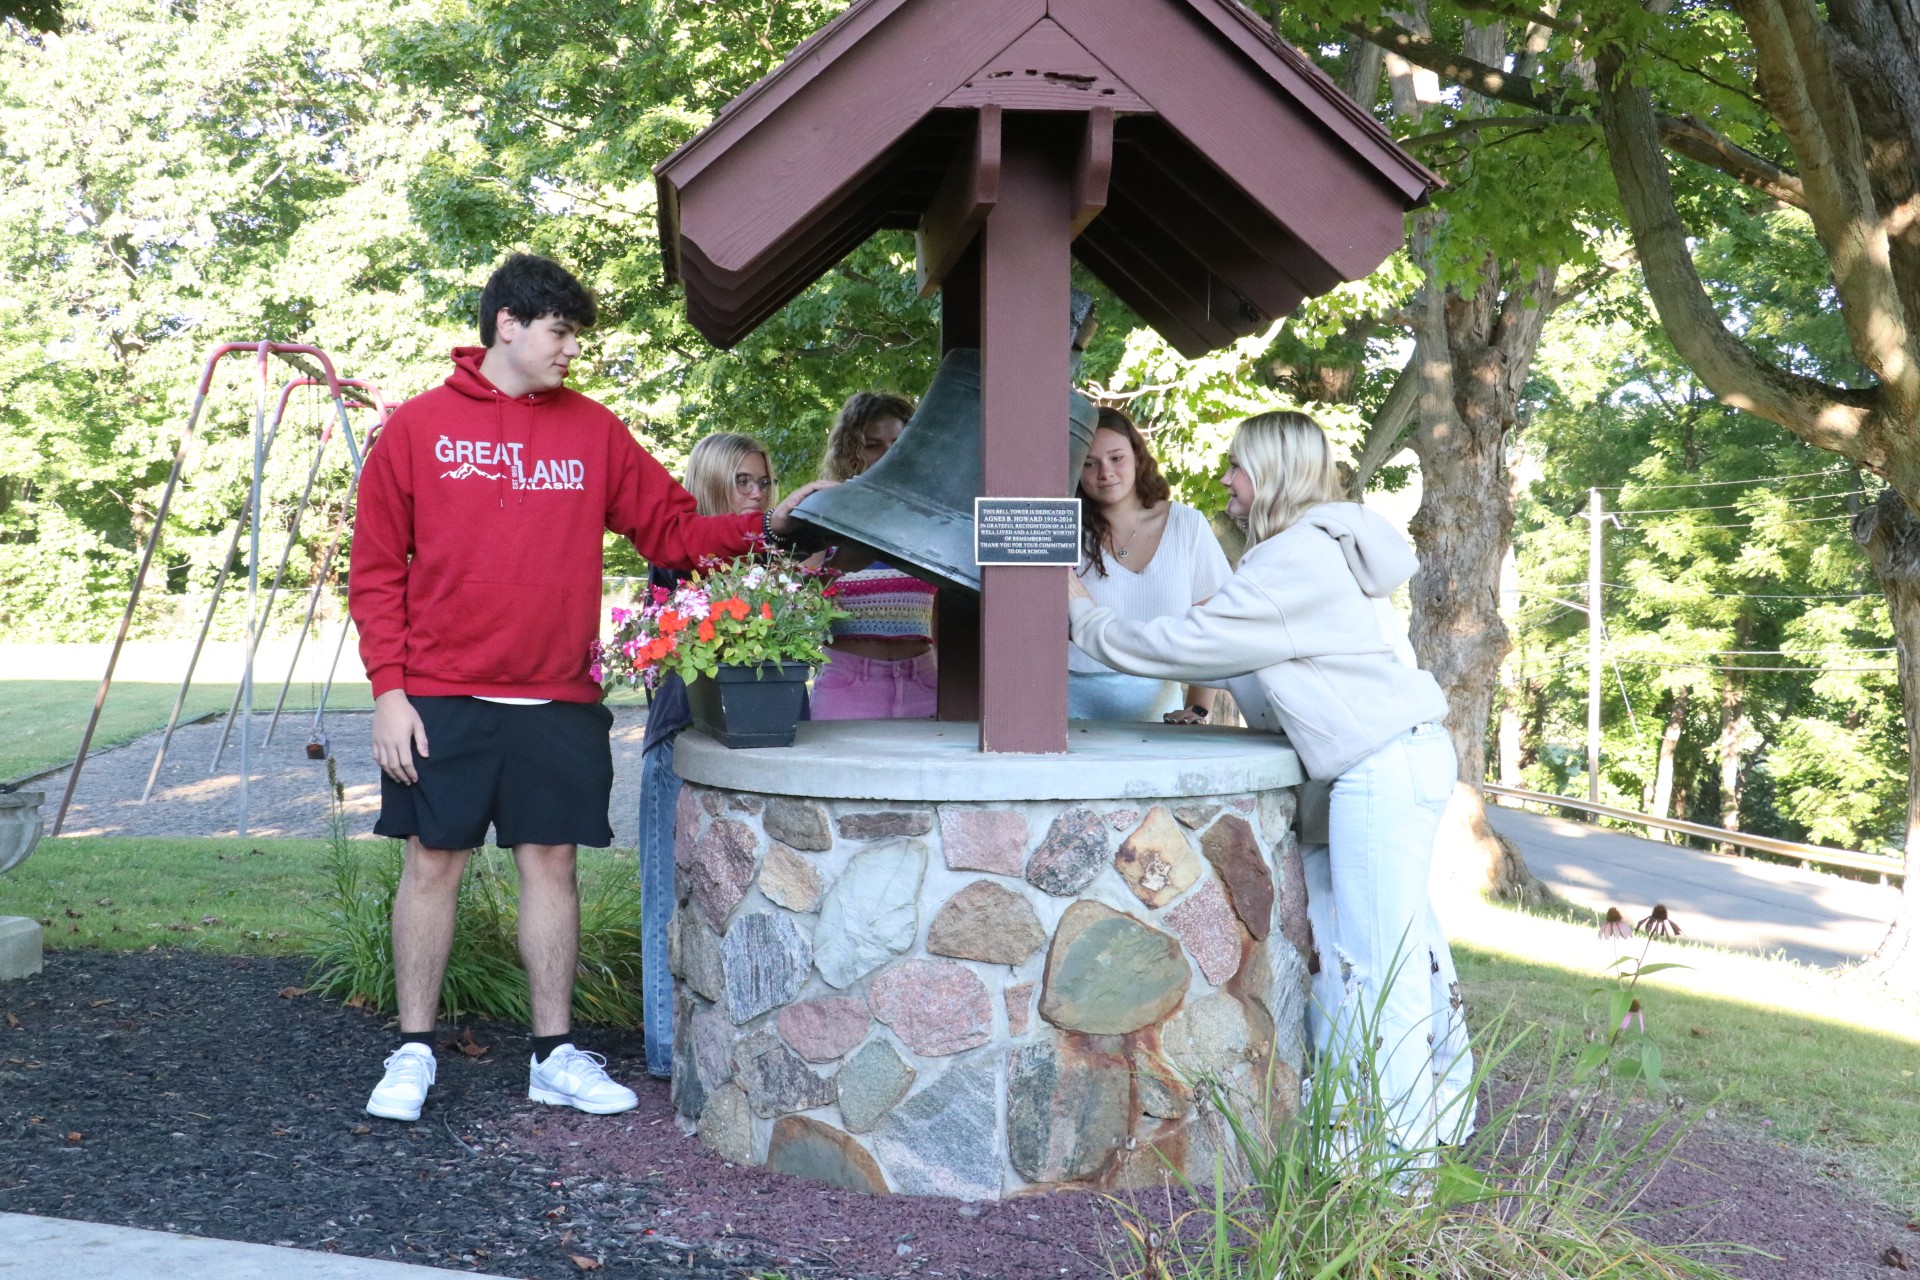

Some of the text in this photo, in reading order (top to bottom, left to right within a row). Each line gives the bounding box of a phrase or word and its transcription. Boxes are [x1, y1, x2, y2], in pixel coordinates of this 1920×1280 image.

[435, 440, 523, 465] GREAT
[518, 460, 584, 483] LAND
[519, 482, 584, 490] ALASKA
